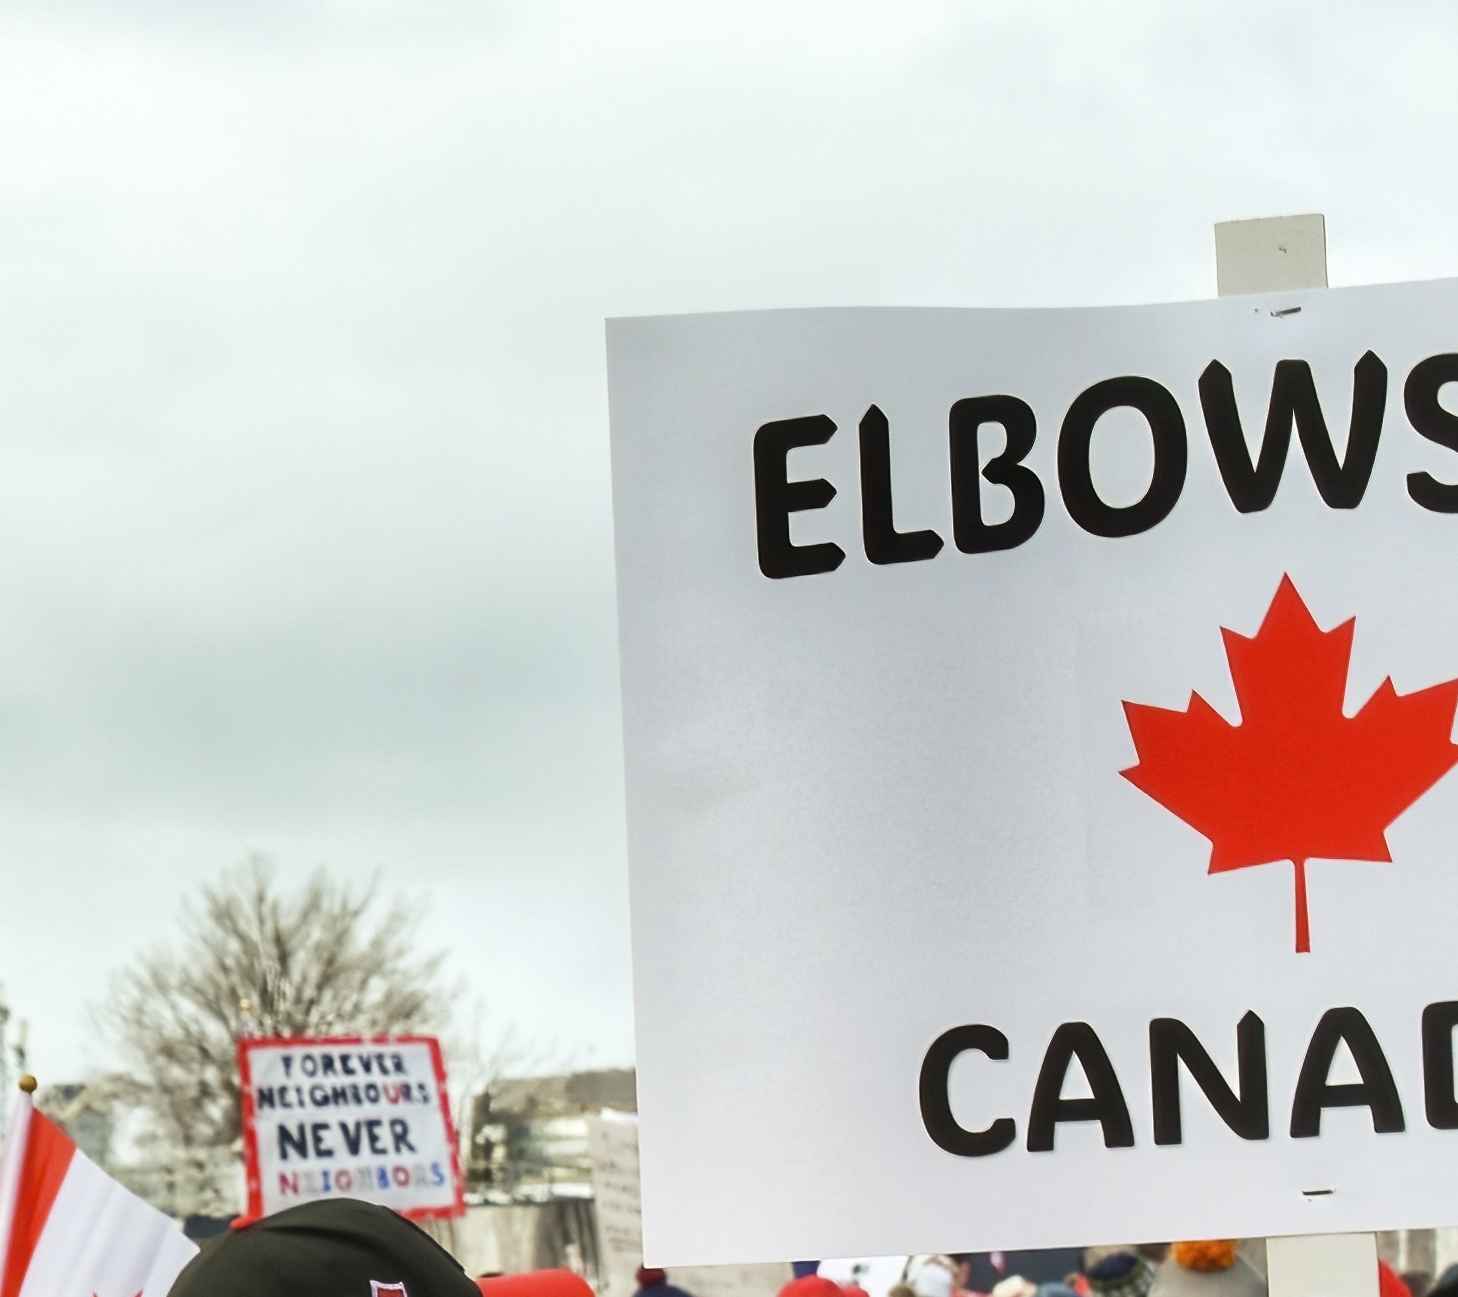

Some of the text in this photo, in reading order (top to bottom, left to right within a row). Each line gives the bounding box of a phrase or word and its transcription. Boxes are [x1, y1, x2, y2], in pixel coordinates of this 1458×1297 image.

[281, 1052, 407, 1078] FOREVER
[257, 1081, 431, 1110] NEIGHBOURS
[277, 1117, 418, 1161] NEVER
